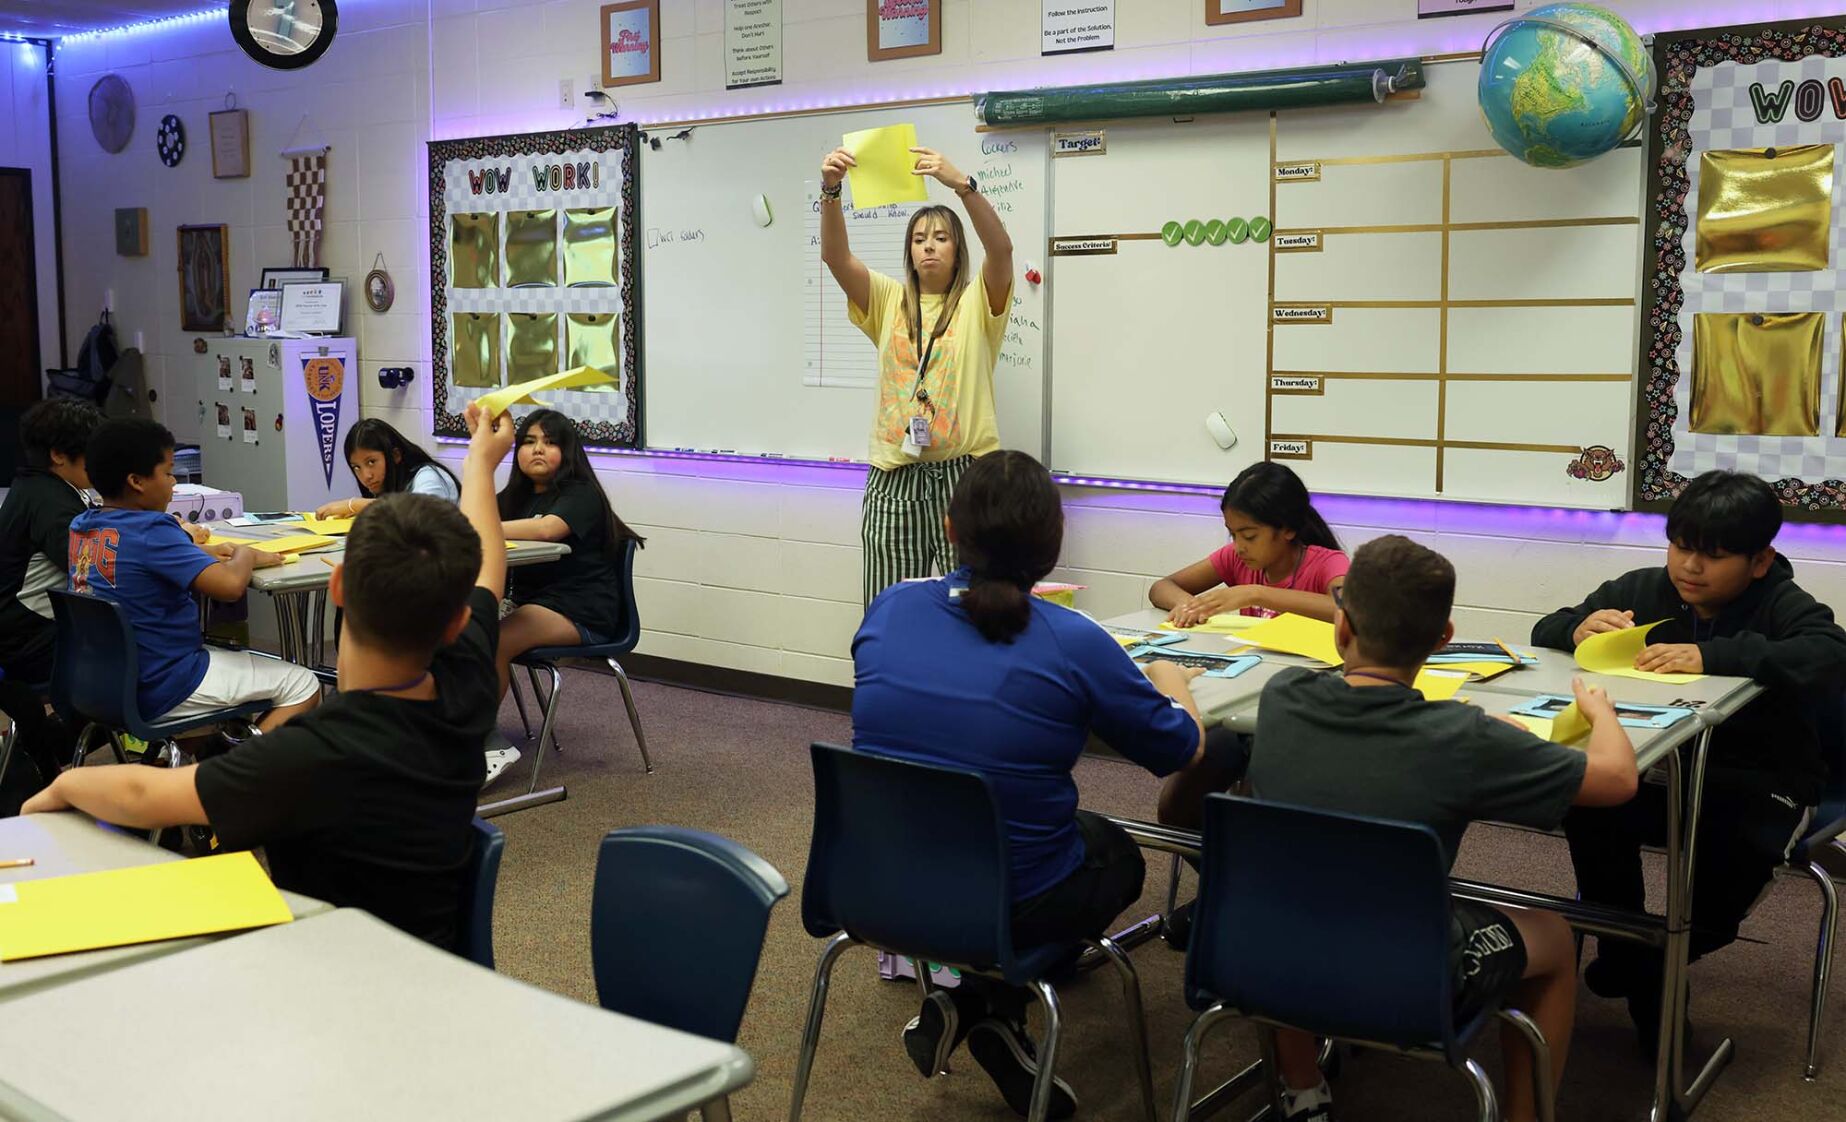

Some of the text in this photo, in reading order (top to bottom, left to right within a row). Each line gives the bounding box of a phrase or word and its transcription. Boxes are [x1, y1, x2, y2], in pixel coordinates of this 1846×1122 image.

[1057, 28, 1069, 36] part
[1070, 26, 1077, 34] of
[1077, 25, 1087, 33] the
[1067, 36, 1077, 44] the
[468, 161, 600, 196] WOW WORK!
[1055, 242, 1082, 251] Success
[315, 401, 337, 464] LOPERS
